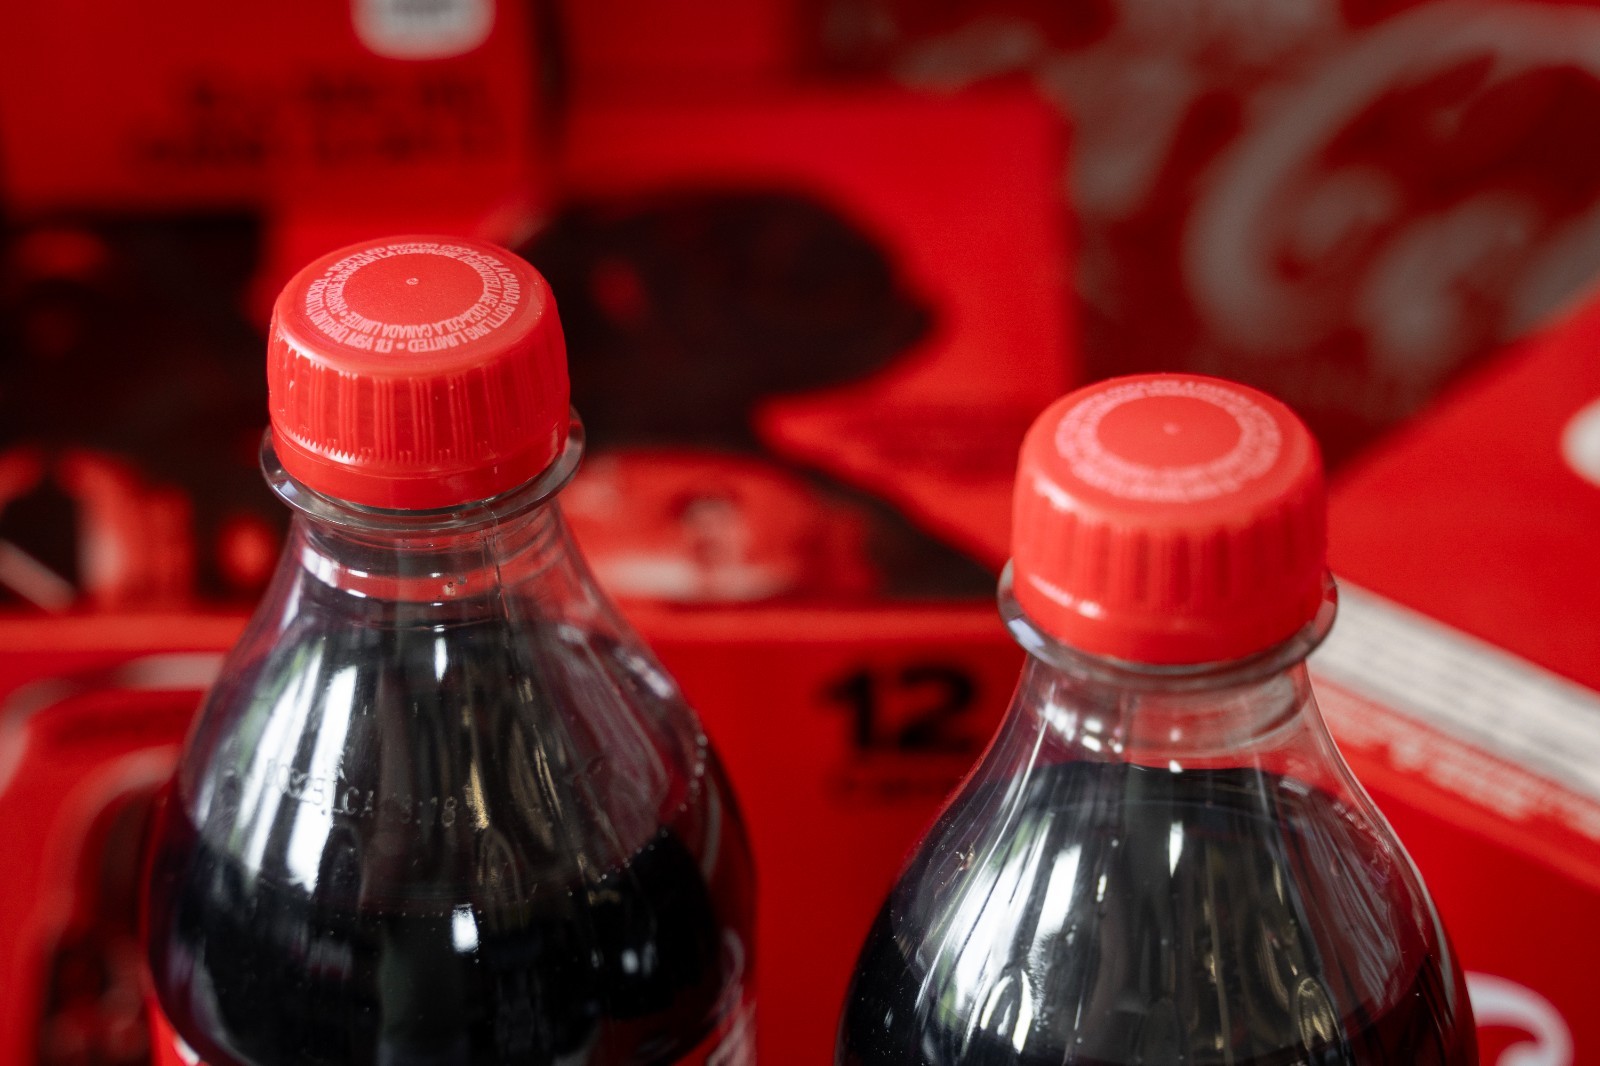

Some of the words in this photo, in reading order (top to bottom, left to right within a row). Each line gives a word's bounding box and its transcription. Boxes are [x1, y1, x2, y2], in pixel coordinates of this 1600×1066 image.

[440, 245, 511, 273] COCA-COLA
[500, 272, 521, 305] CANADA
[381, 323, 433, 339] CANADA
[432, 303, 491, 336] COCA-COLA
[463, 302, 516, 341] BOTTLING
[407, 332, 469, 353] LIMITED
[817, 664, 981, 755] 12
